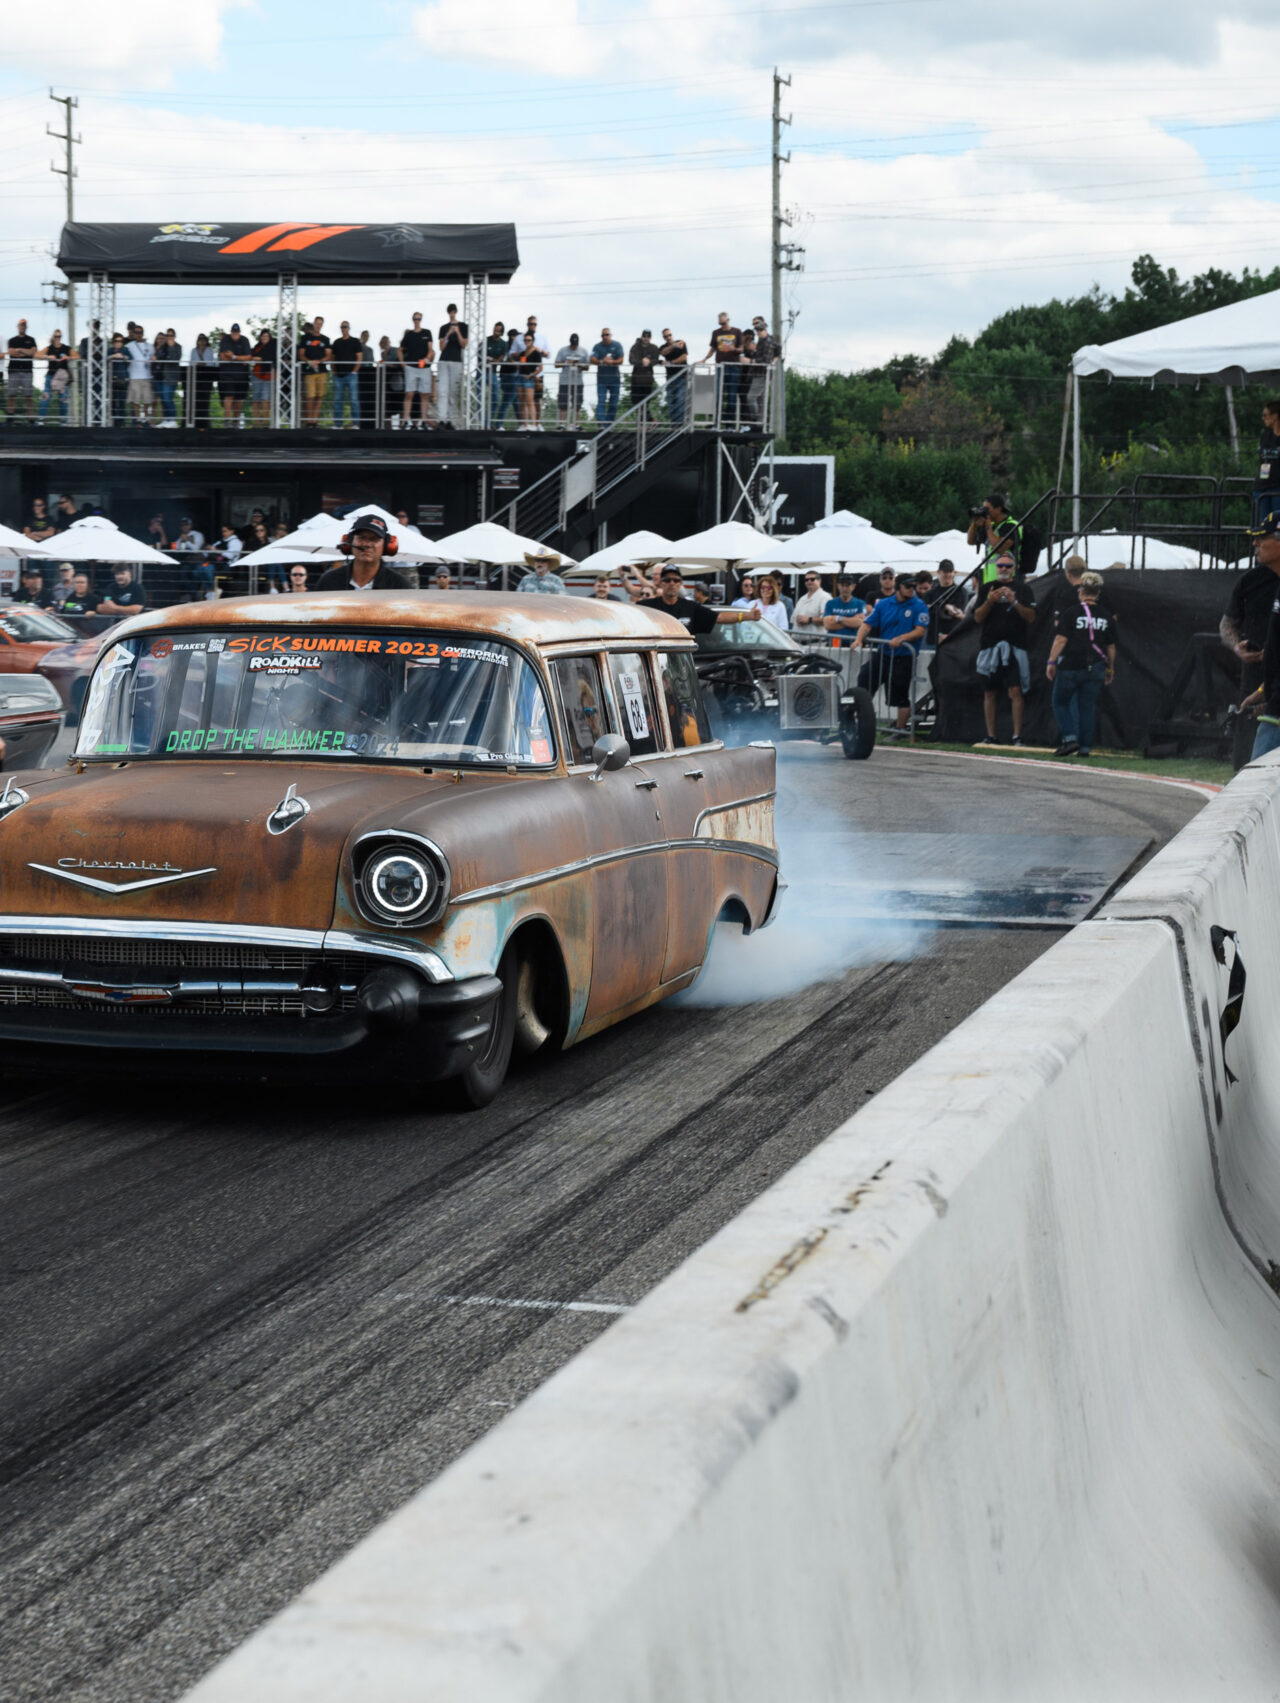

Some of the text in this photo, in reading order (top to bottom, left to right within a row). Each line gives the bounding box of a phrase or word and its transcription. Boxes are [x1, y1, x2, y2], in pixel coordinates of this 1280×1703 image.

[171, 642, 207, 651] BRAKES
[290, 637, 382, 653] SUMMER
[385, 640, 439, 656] 2023
[445, 646, 509, 662] OVERDRIVE
[249, 656, 320, 669] ROADKILL
[266, 667, 300, 675] NIGHTS
[166, 729, 218, 752] DROP
[222, 728, 259, 750] THE
[263, 729, 345, 752] HAMMER
[57, 857, 183, 873] Chevrolet
